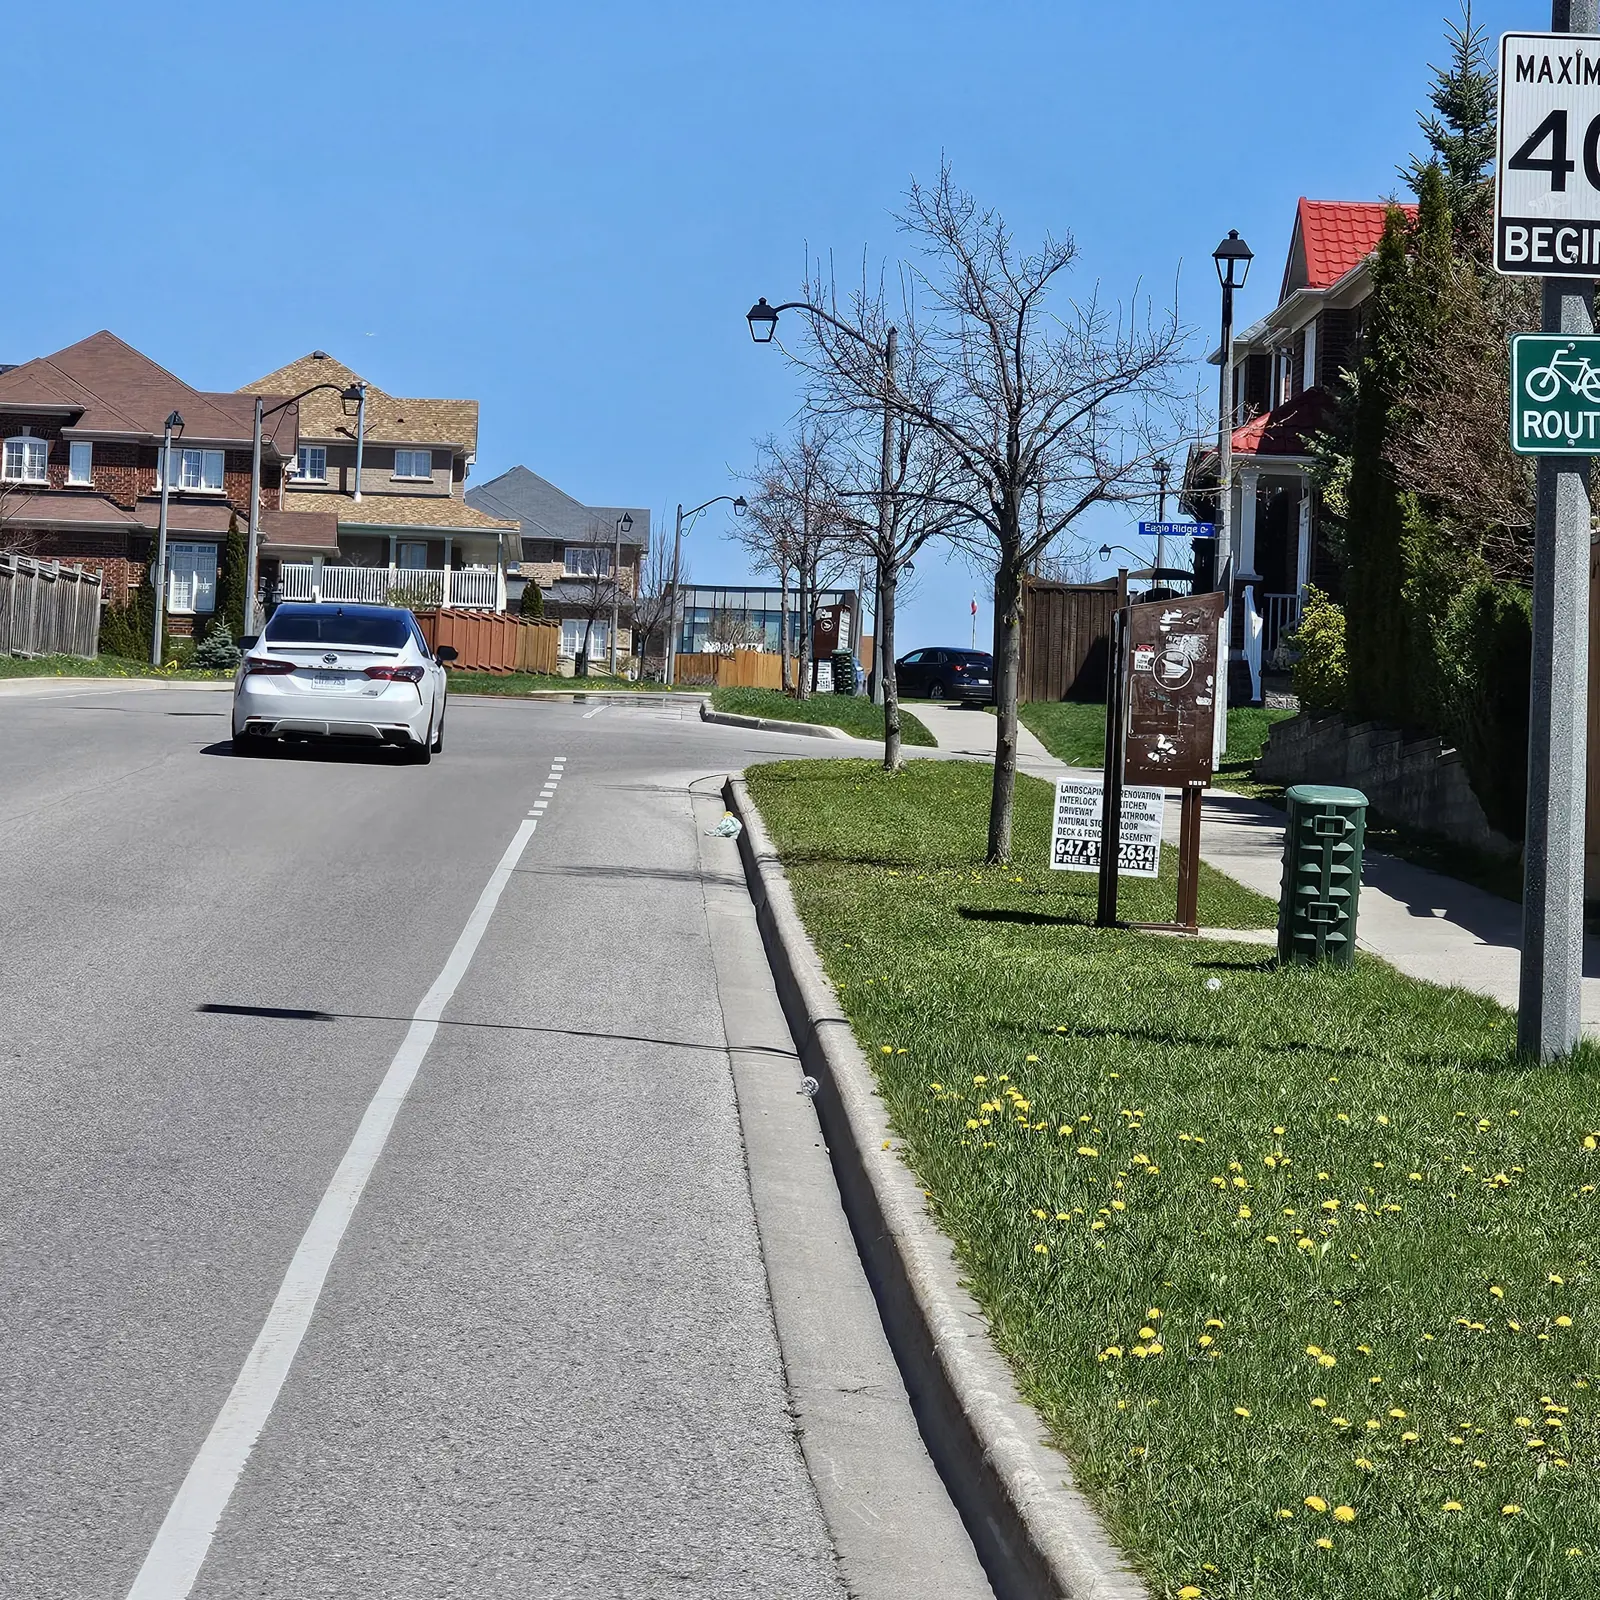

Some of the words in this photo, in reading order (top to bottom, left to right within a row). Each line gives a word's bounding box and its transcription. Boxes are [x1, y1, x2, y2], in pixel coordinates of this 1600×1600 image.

[1523, 410, 1600, 439] ROUT
[1144, 523, 1169, 534] Eagle
[1172, 524, 1198, 536] Ridge
[1061, 785, 1104, 796] LANDSCAPIN
[1059, 795, 1098, 806] INTERLOCK
[1120, 800, 1147, 810] ITCHEN
[1059, 806, 1094, 816] DRIVEWAY
[1120, 811, 1156, 821] ATHROOM
[1058, 817, 1088, 826] NATURAL
[1120, 822, 1138, 831] LOOR
[1057, 827, 1076, 836] DECK
[1077, 828, 1082, 837] &
[1084, 829, 1103, 838] FENC
[1120, 833, 1153, 842] ASEMENT
[1056, 854, 1087, 864] FREE
